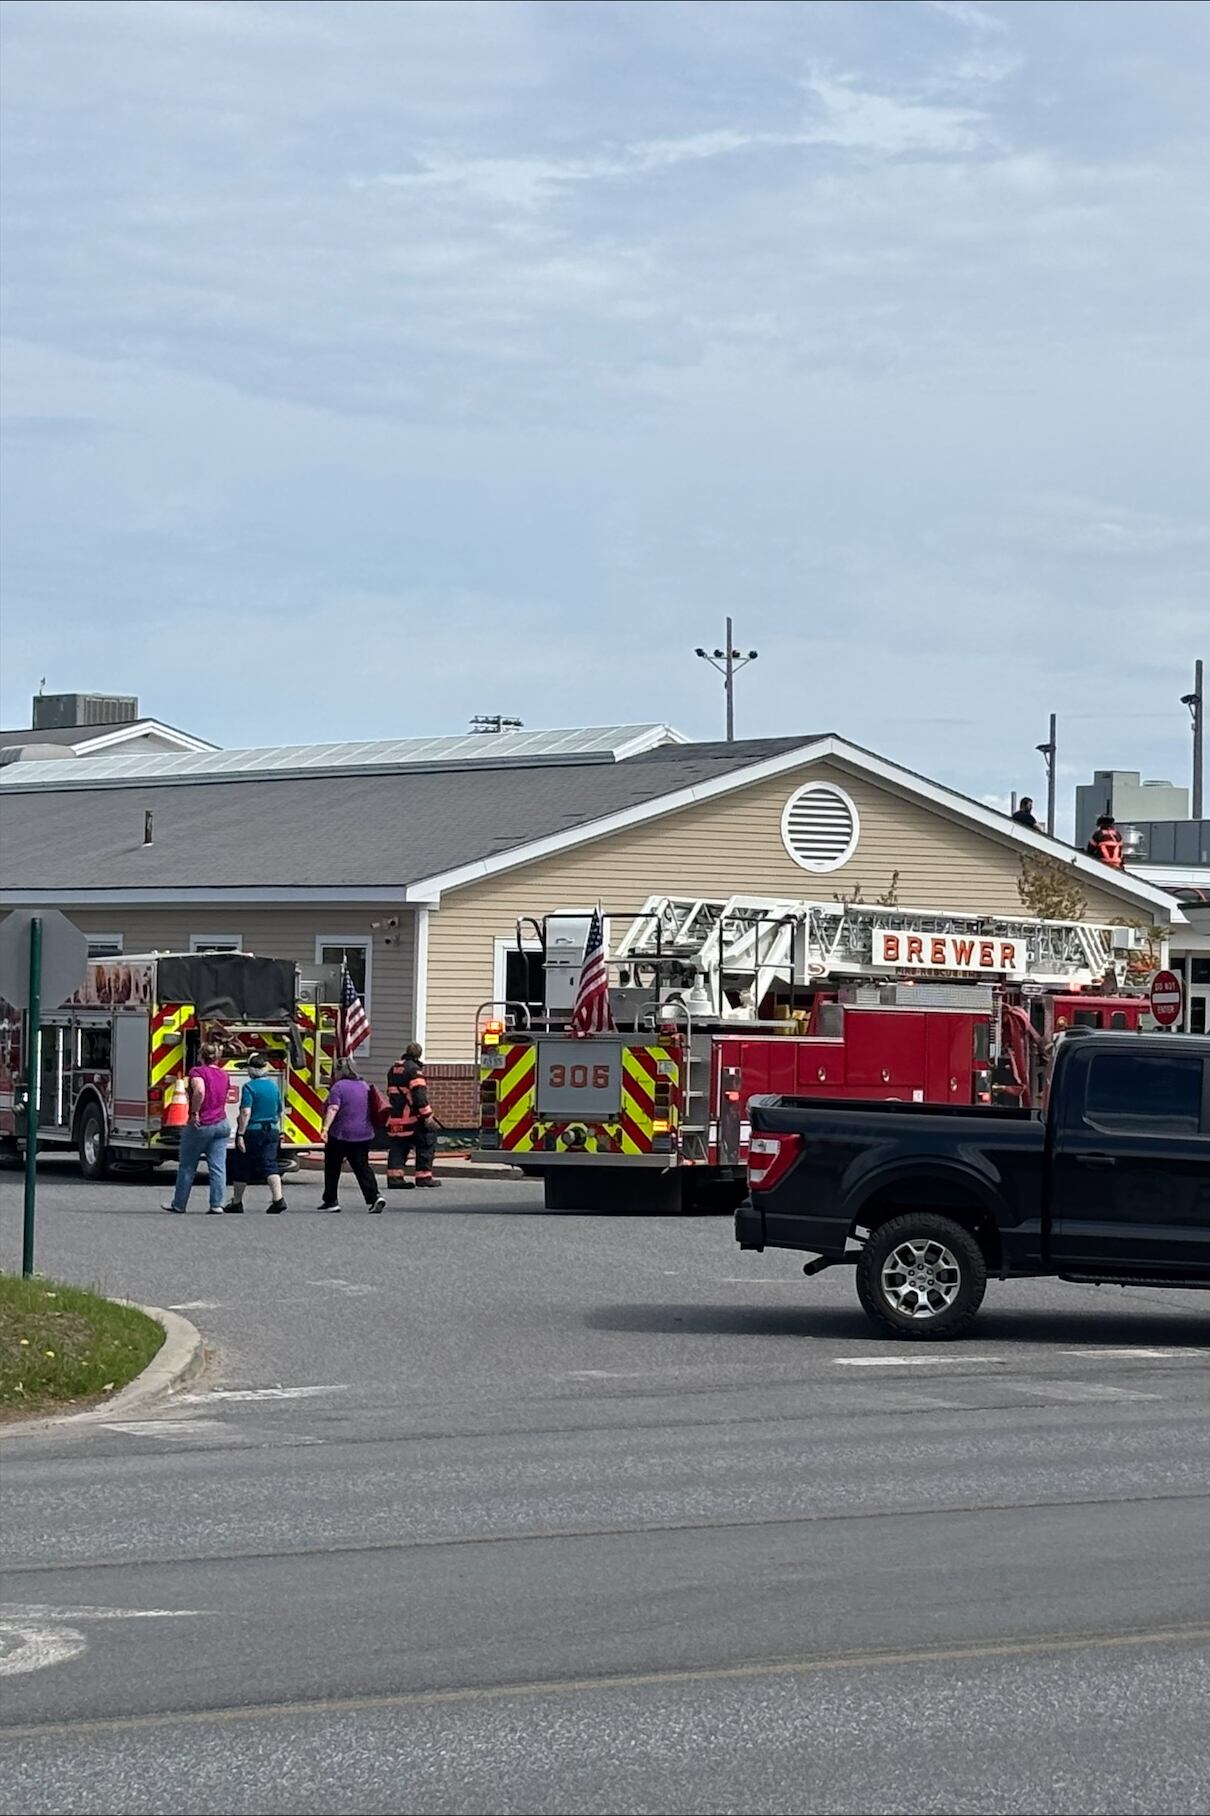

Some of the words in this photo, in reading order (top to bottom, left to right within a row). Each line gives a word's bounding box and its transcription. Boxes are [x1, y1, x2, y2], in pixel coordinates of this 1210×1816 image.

[883, 934, 1016, 969] BREWER
[1154, 982, 1163, 991] DO
[1164, 981, 1176, 991] NOT
[1157, 1004, 1175, 1014] ENTER
